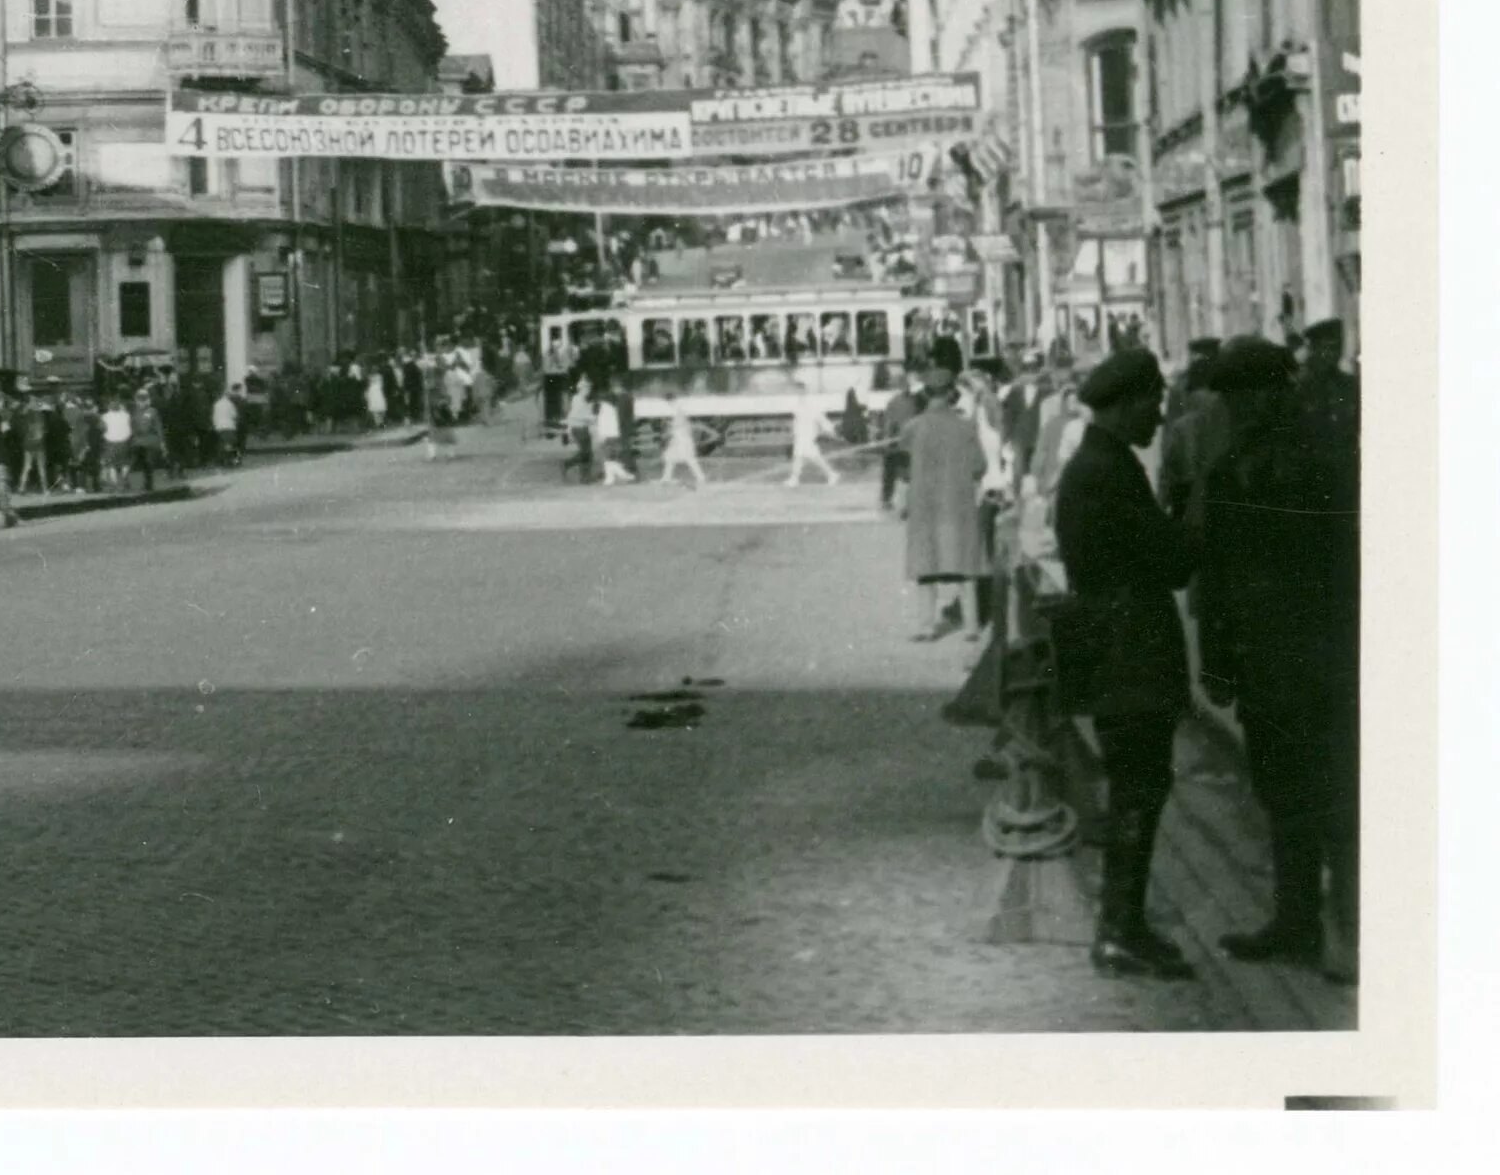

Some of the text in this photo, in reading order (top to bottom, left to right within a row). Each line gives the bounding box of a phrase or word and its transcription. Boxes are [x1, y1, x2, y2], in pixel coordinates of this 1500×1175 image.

[196, 94, 589, 115] КРЕПИ ОБОРОНУ СССР
[178, 116, 208, 150] 4
[505, 126, 682, 155] ОСОАВИАХИМА
[809, 118, 861, 144] 28
[868, 116, 974, 139] СЕНТЯБРЯ
